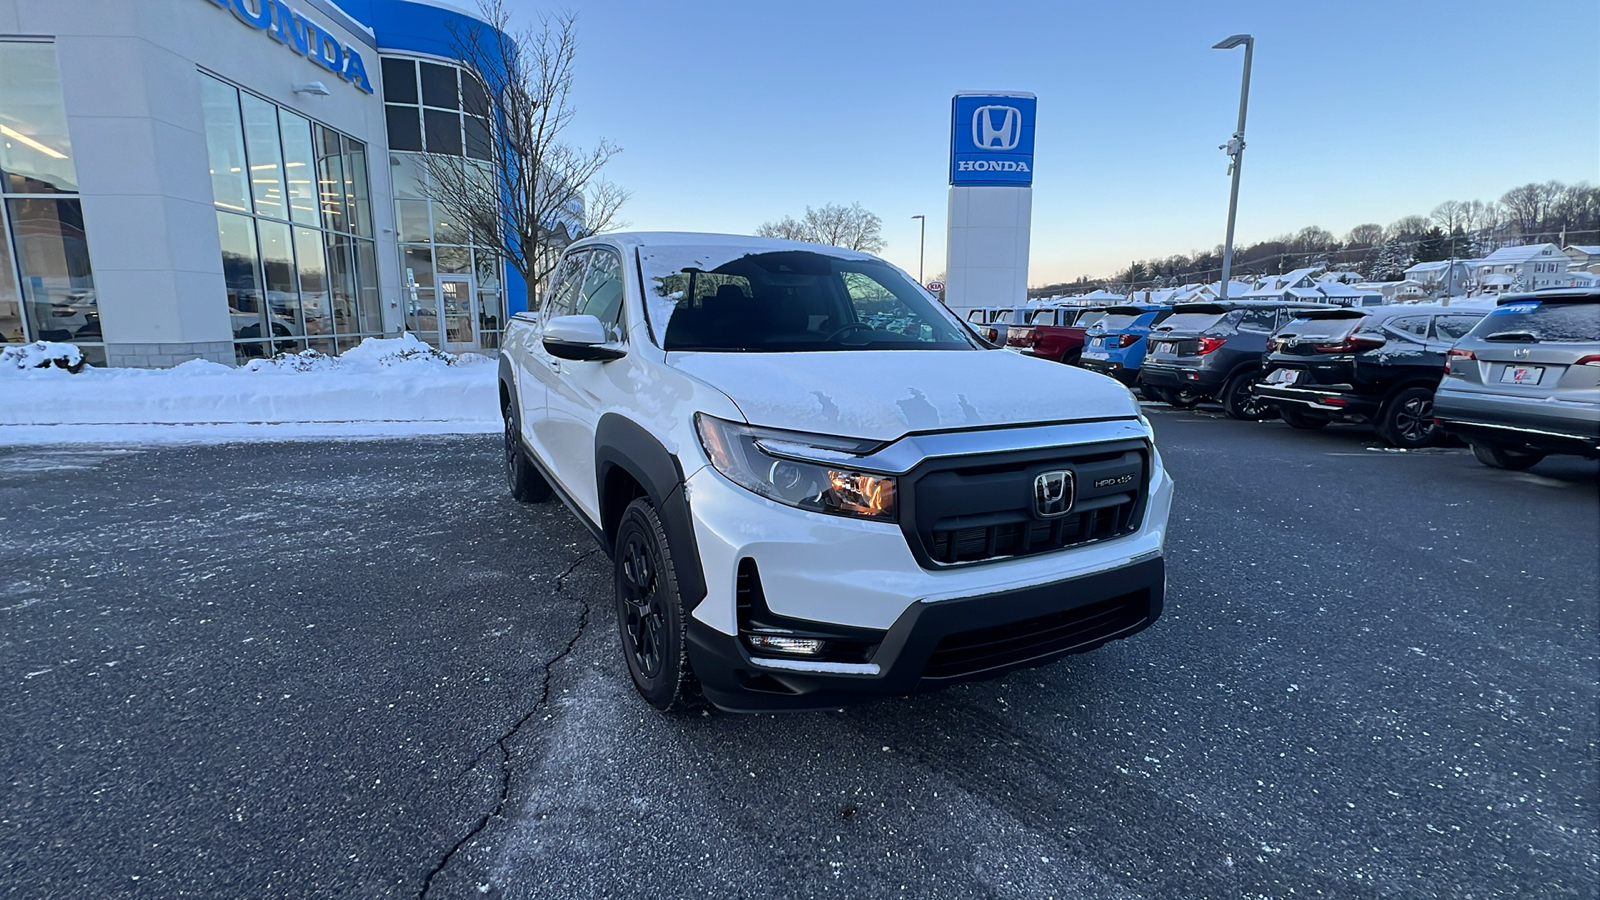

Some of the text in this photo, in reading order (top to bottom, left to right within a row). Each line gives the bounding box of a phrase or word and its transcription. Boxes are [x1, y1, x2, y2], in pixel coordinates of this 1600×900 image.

[205, 0, 374, 94] ONDA
[957, 160, 1030, 172] HONDA
[1095, 478, 1116, 488] HPD
